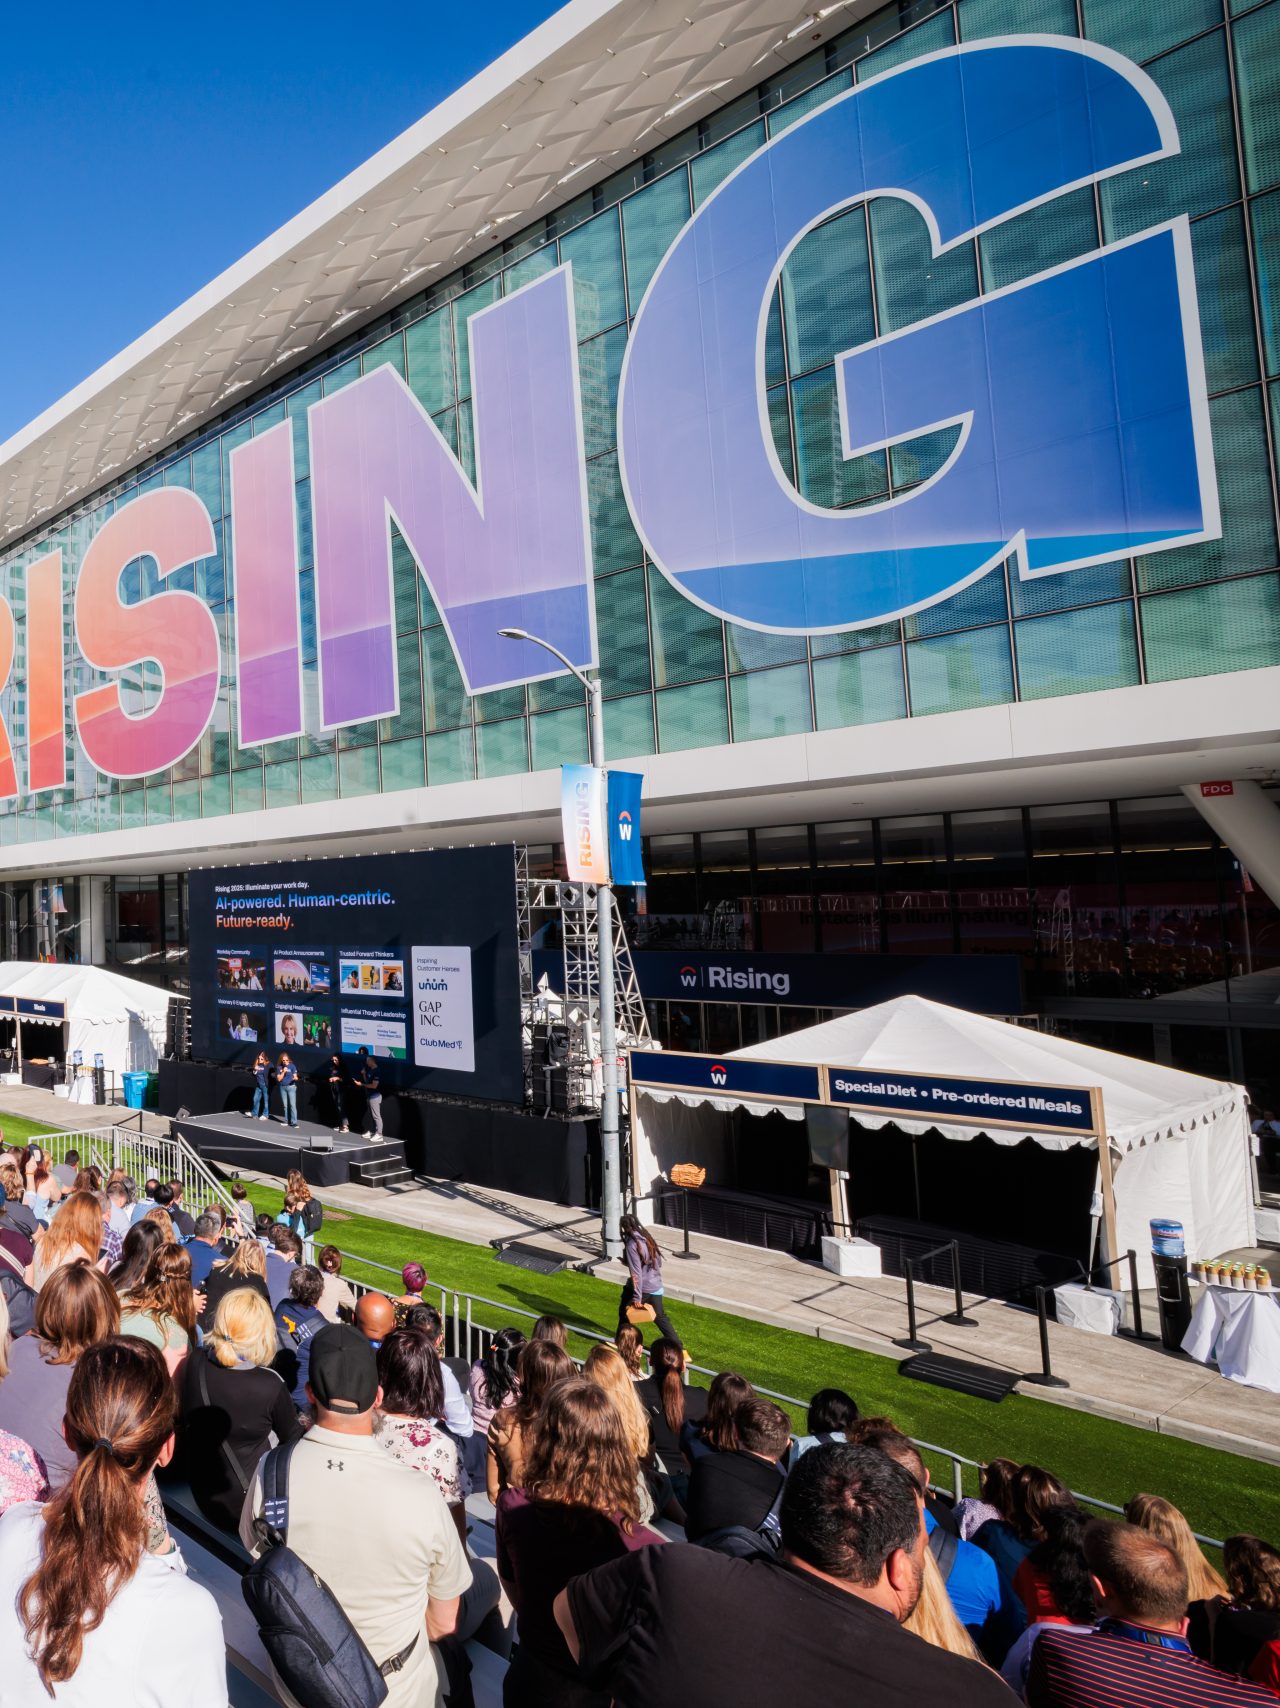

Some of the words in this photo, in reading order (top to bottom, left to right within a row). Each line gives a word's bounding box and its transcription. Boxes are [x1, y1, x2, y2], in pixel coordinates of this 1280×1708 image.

[1203, 784, 1231, 794] FDC
[575, 782, 592, 867] RISING
[215, 885, 231, 893] Rising
[270, 883, 283, 891] your
[283, 881, 297, 889] work
[215, 893, 286, 912] AI-powered.
[288, 889, 396, 908] Human-centric.
[216, 913, 295, 930] Future-ready.
[416, 957, 438, 965] Inspiring
[708, 965, 790, 995] Rising
[418, 1000, 442, 1013] GAP
[420, 1014, 443, 1027] INC.
[420, 1038, 437, 1047] Club
[437, 1039, 456, 1049] Med
[834, 1079, 886, 1097] Special
[887, 1082, 917, 1098] Diet
[931, 1087, 1027, 1109] Pre-ordered
[1028, 1096, 1083, 1116] Meals
